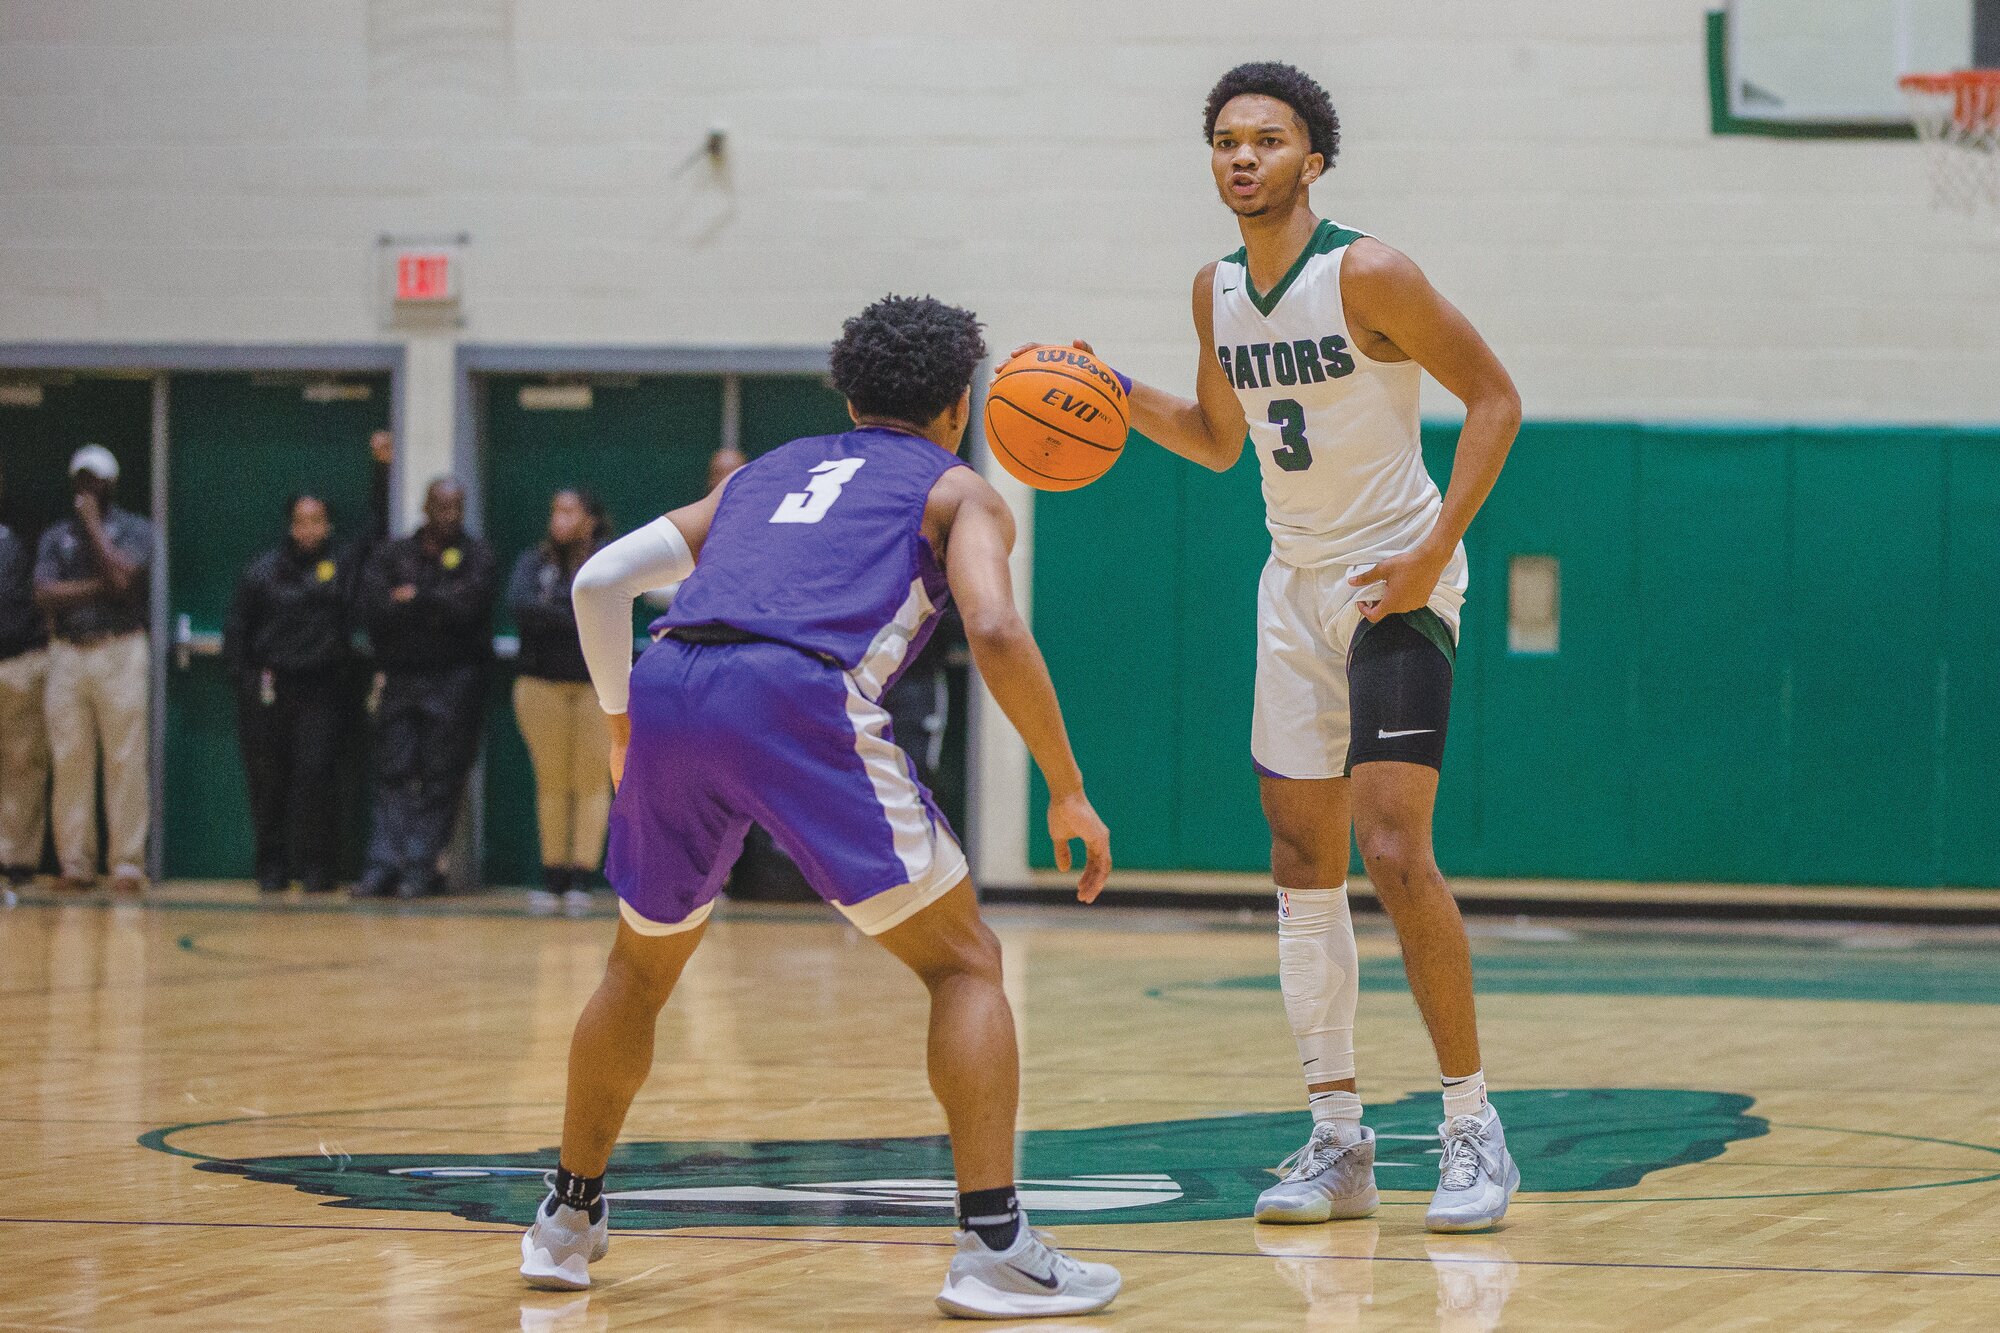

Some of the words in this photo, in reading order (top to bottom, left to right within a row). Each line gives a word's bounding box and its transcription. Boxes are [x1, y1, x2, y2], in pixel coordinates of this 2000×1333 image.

[1218, 334, 1355, 389] GATORS
[1042, 388, 1099, 423] EVO
[1268, 398, 1313, 472] 3
[769, 457, 866, 524] 3
